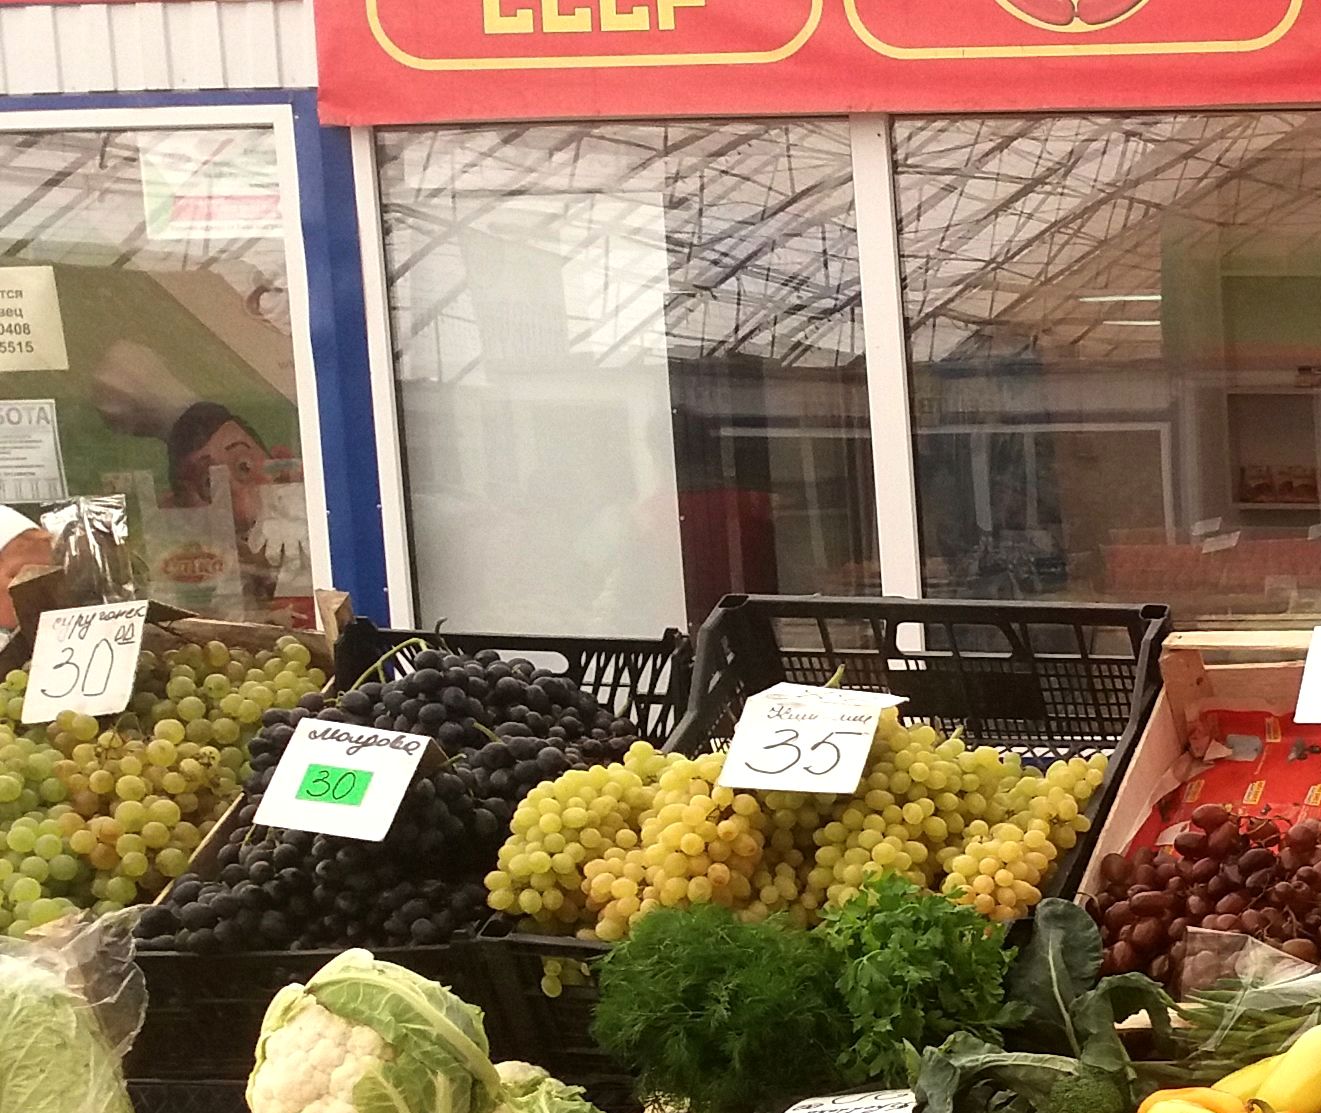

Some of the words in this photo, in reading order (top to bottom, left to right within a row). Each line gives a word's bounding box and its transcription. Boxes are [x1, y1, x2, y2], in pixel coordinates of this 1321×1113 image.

[41, 638, 114, 698] 30
[745, 729, 870, 776] 35
[306, 770, 357, 800] 30
